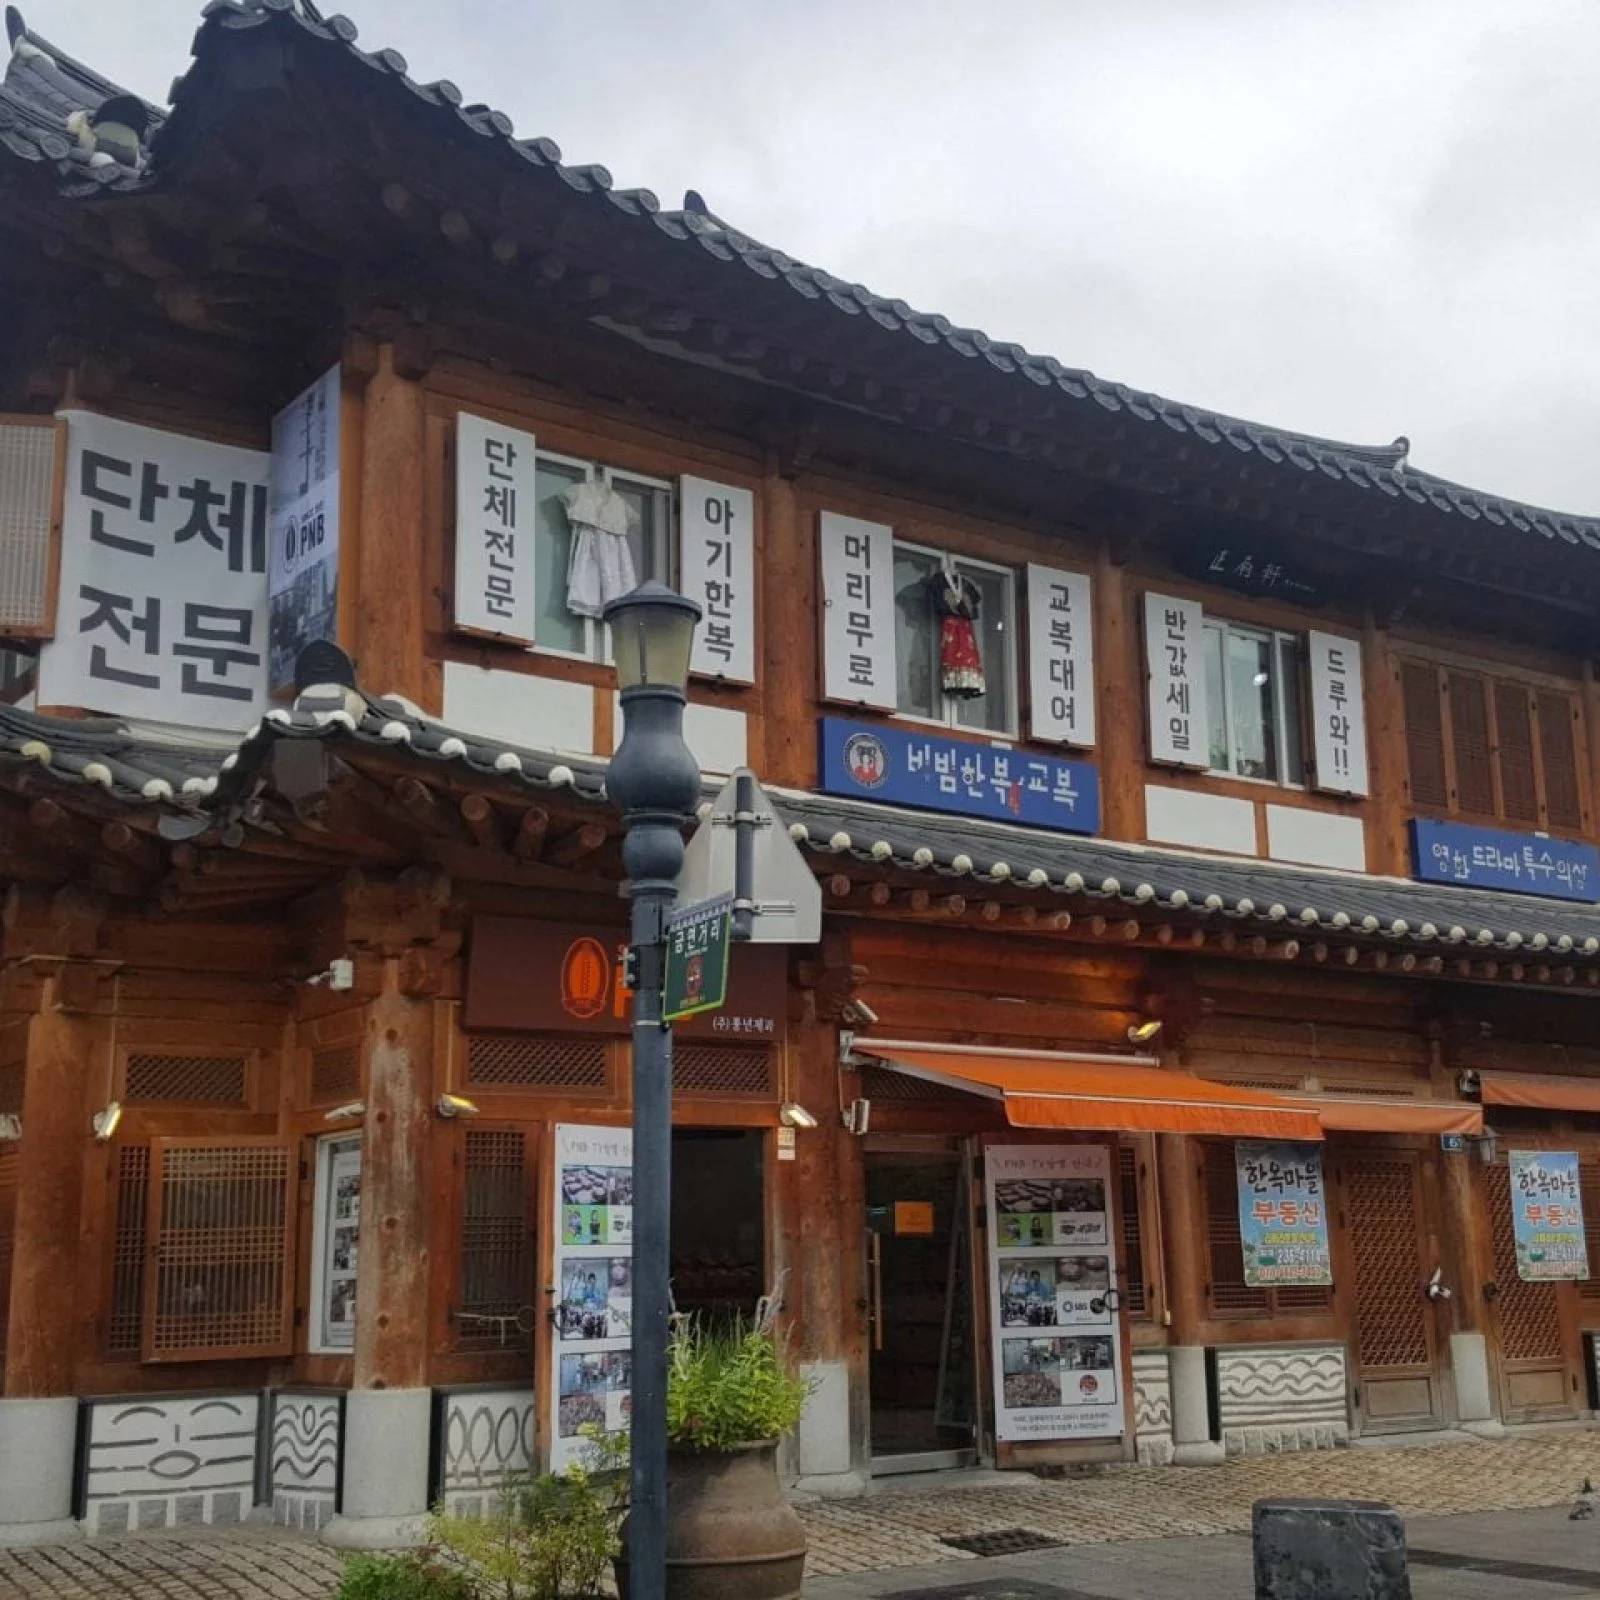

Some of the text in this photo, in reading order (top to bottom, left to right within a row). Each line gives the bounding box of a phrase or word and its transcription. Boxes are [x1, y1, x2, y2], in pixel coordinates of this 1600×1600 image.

[81, 449, 268, 573] 단체
[484, 438, 518, 618] 단체전문
[704, 496, 735, 663] 아기한복
[844, 534, 875, 687] 머리무료
[79, 584, 261, 702] 전문
[1049, 584, 1076, 730] 교복대여
[1164, 609, 1191, 751] 반값세일
[1327, 648, 1351, 776] 드루와!!
[1027, 762, 1080, 814] 교복
[1472, 845, 1521, 879] 드라마
[1252, 1200, 1321, 1227] 부동산
[1525, 1203, 1579, 1228] 부동산
